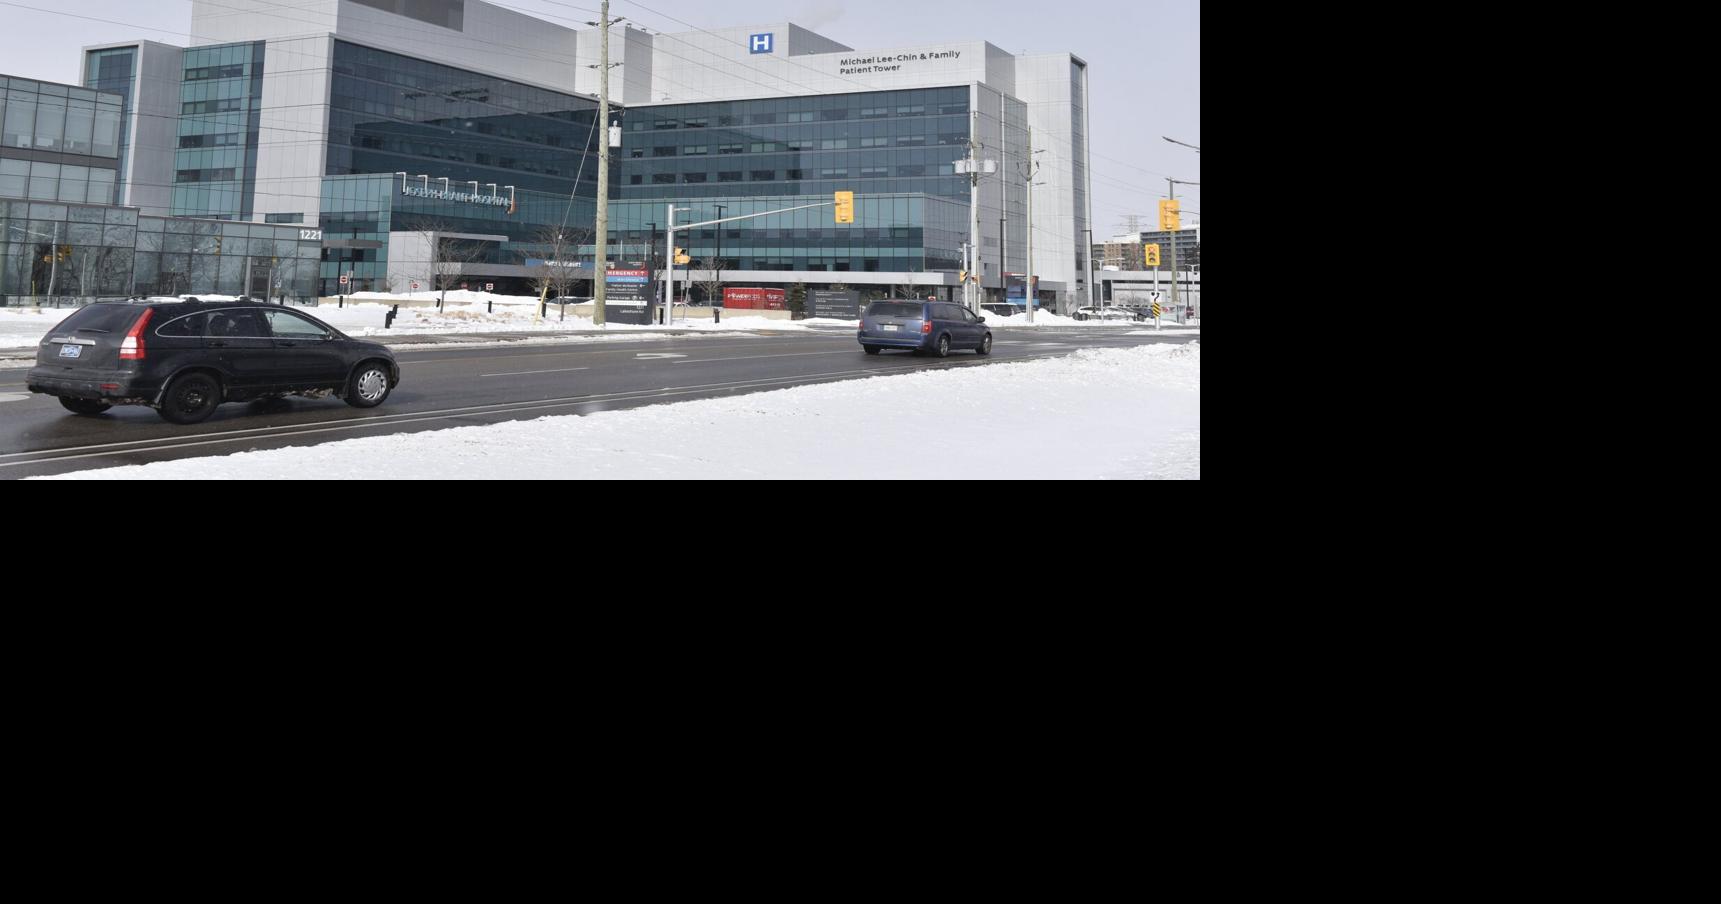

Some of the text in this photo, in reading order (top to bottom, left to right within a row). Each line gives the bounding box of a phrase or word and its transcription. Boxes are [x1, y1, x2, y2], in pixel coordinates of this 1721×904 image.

[753, 35, 769, 51] H
[840, 57, 875, 66] Michael
[877, 54, 918, 63] Lee-Chin
[929, 51, 961, 60] Family
[840, 64, 901, 75] Patient Tower
[300, 230, 322, 240] 1221
